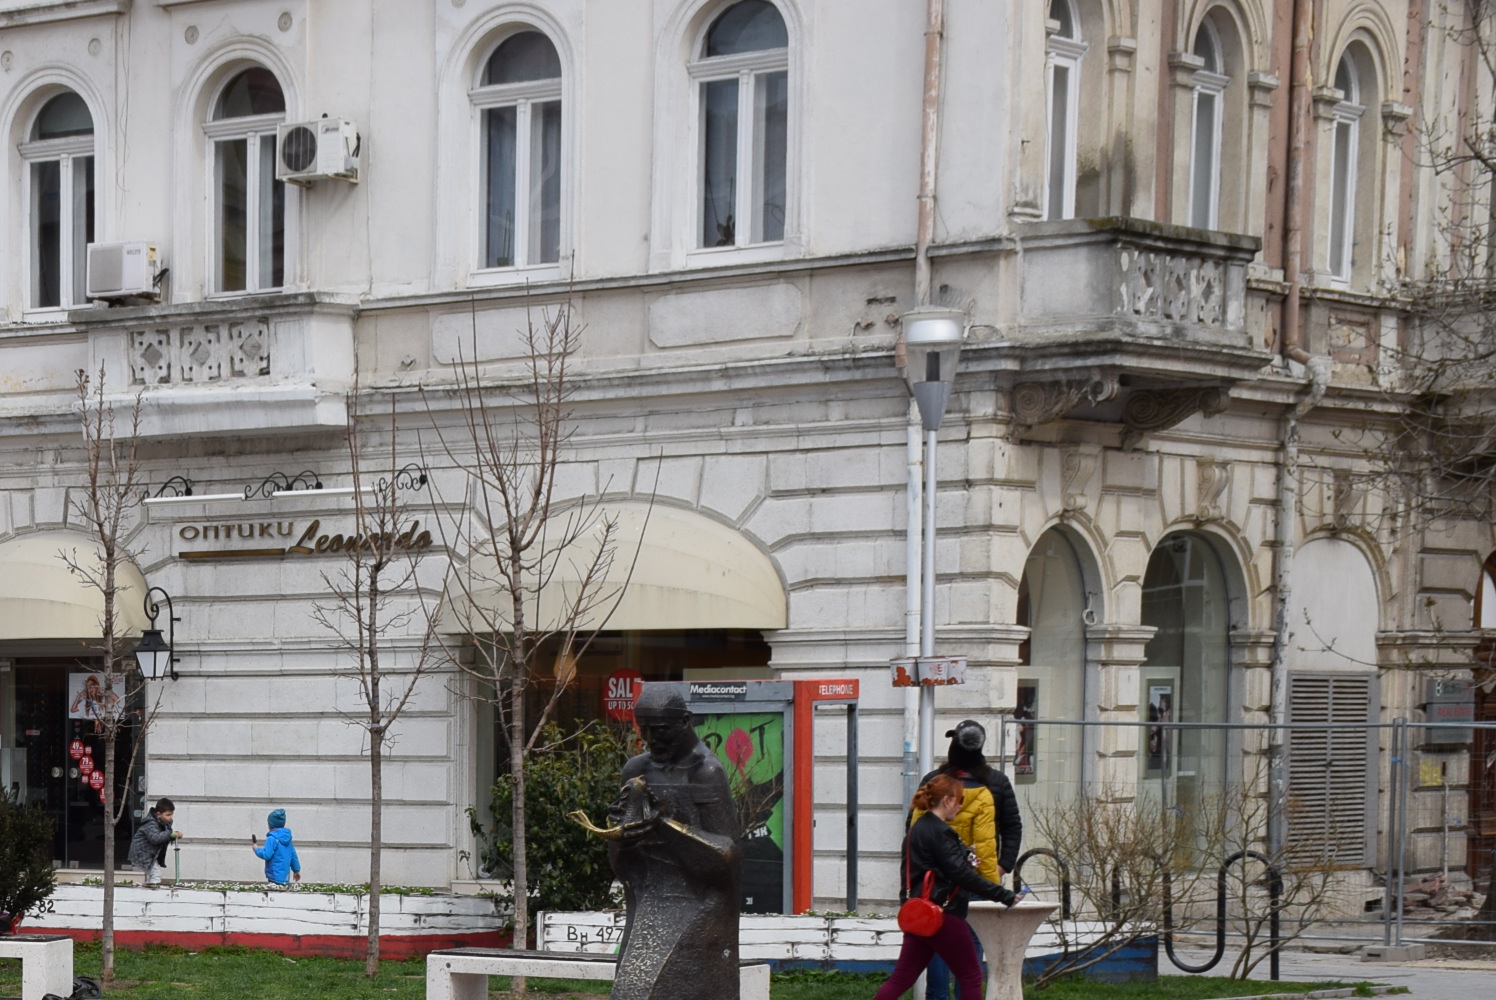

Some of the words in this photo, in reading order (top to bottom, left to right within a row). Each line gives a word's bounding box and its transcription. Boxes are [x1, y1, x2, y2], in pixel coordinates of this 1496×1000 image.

[690, 684, 747, 694] Mediacontact
[819, 684, 854, 696] TELEPHONE
[608, 701, 617, 710] UP
[618, 701, 627, 710] TO
